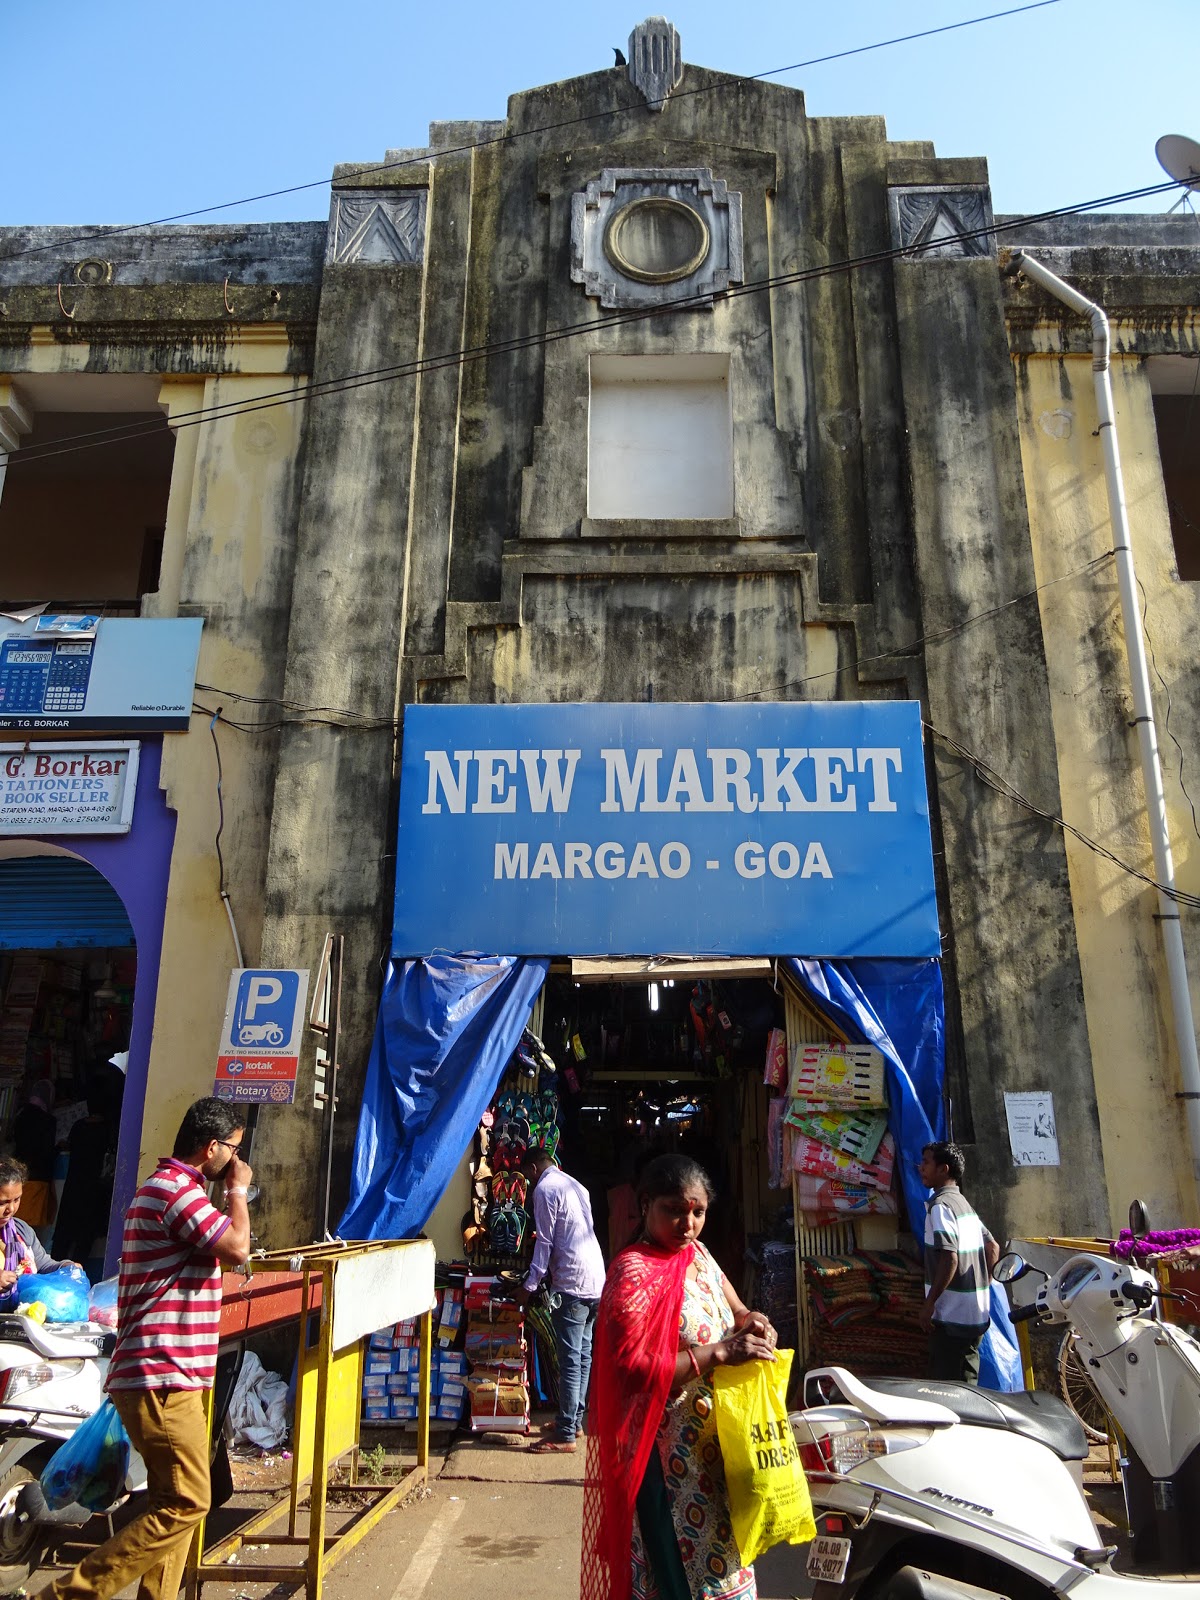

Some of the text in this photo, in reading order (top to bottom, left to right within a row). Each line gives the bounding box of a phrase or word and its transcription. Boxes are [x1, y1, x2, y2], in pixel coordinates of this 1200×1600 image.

[34, 754, 126, 778] Borkar
[422, 747, 902, 814] NEW MARKET
[4, 791, 110, 804] BOOK SELLER
[494, 842, 691, 879] MARGAO
[735, 842, 834, 879] GOA
[244, 976, 283, 1020] P
[245, 1061, 273, 1070] kotak
[235, 1086, 269, 1097] Rotary
